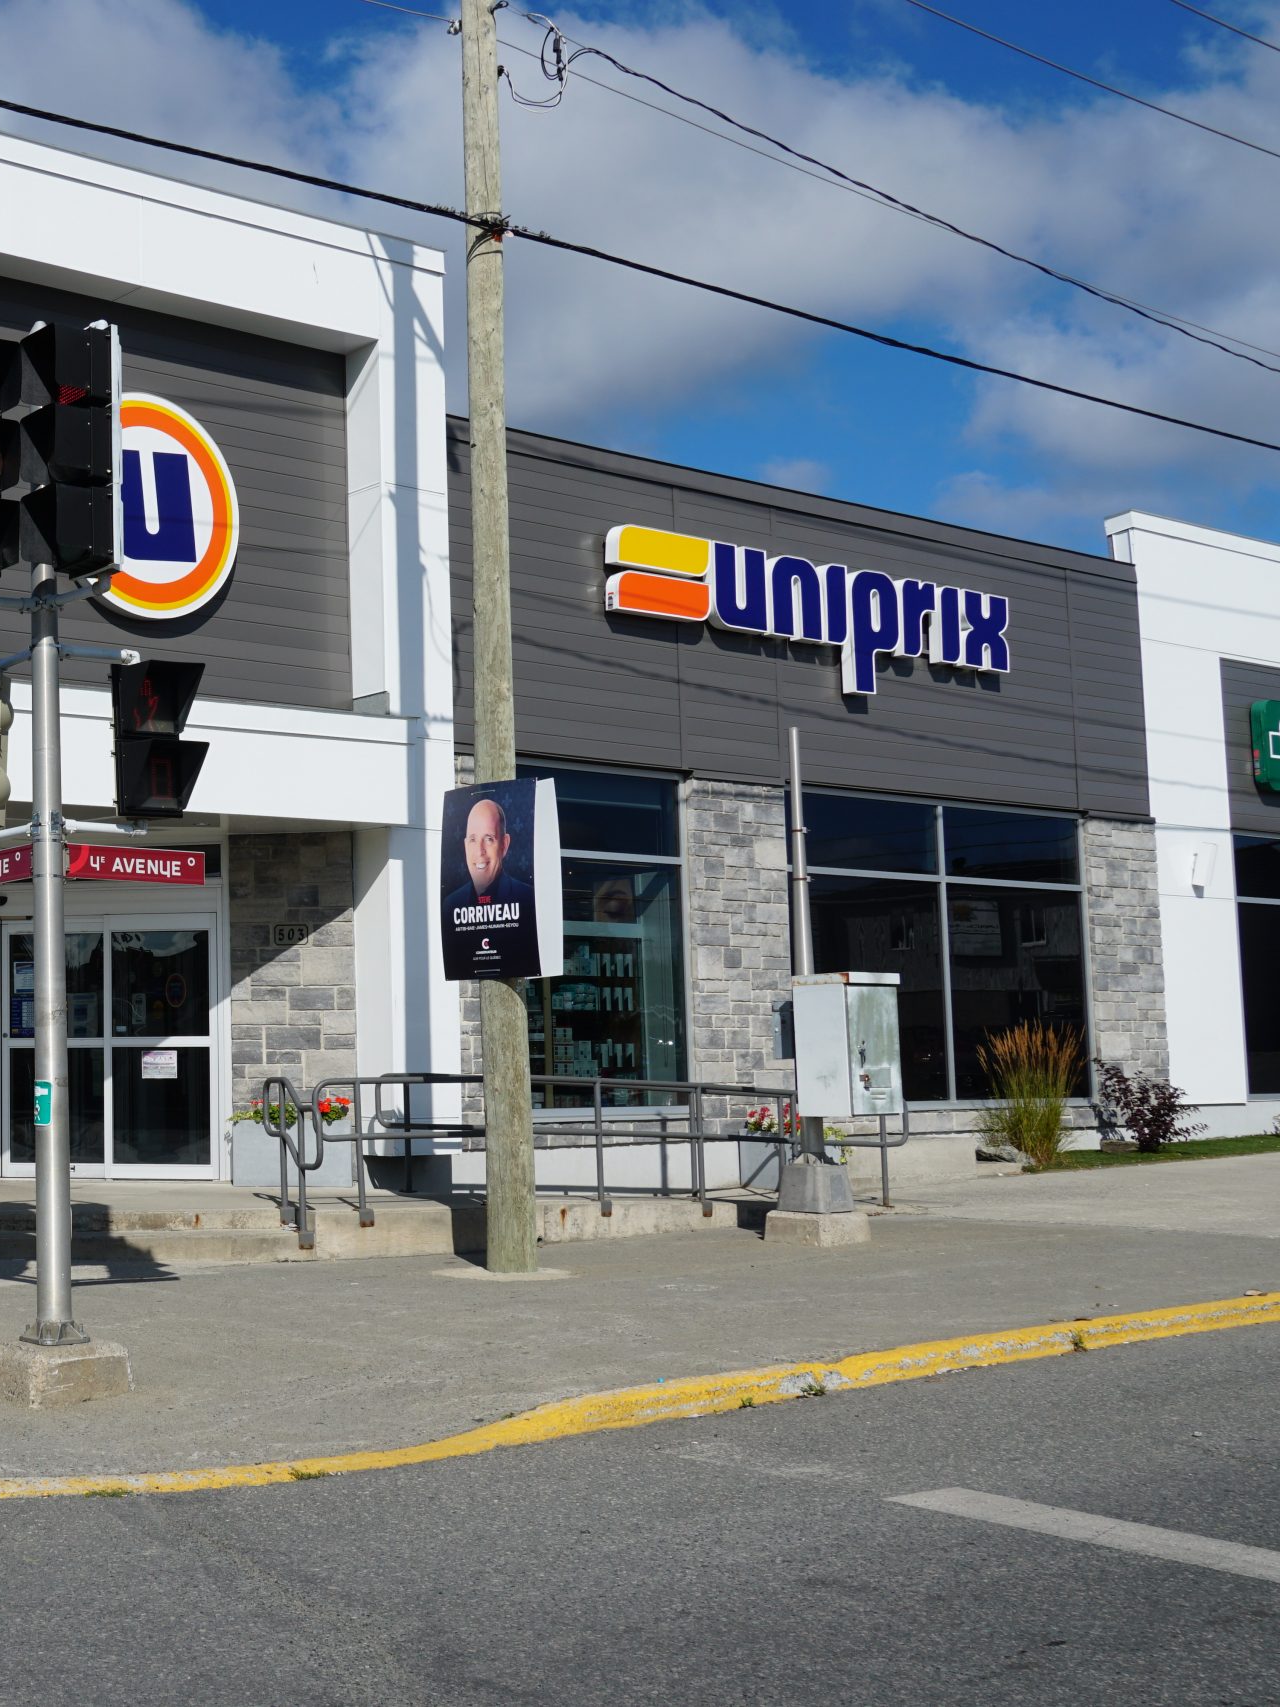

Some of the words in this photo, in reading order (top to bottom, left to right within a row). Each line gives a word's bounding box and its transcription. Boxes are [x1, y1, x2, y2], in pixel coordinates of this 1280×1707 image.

[112, 858, 182, 878] AVENUE
[453, 903, 520, 925] CORRIVEAU
[277, 928, 305, 942] 503
